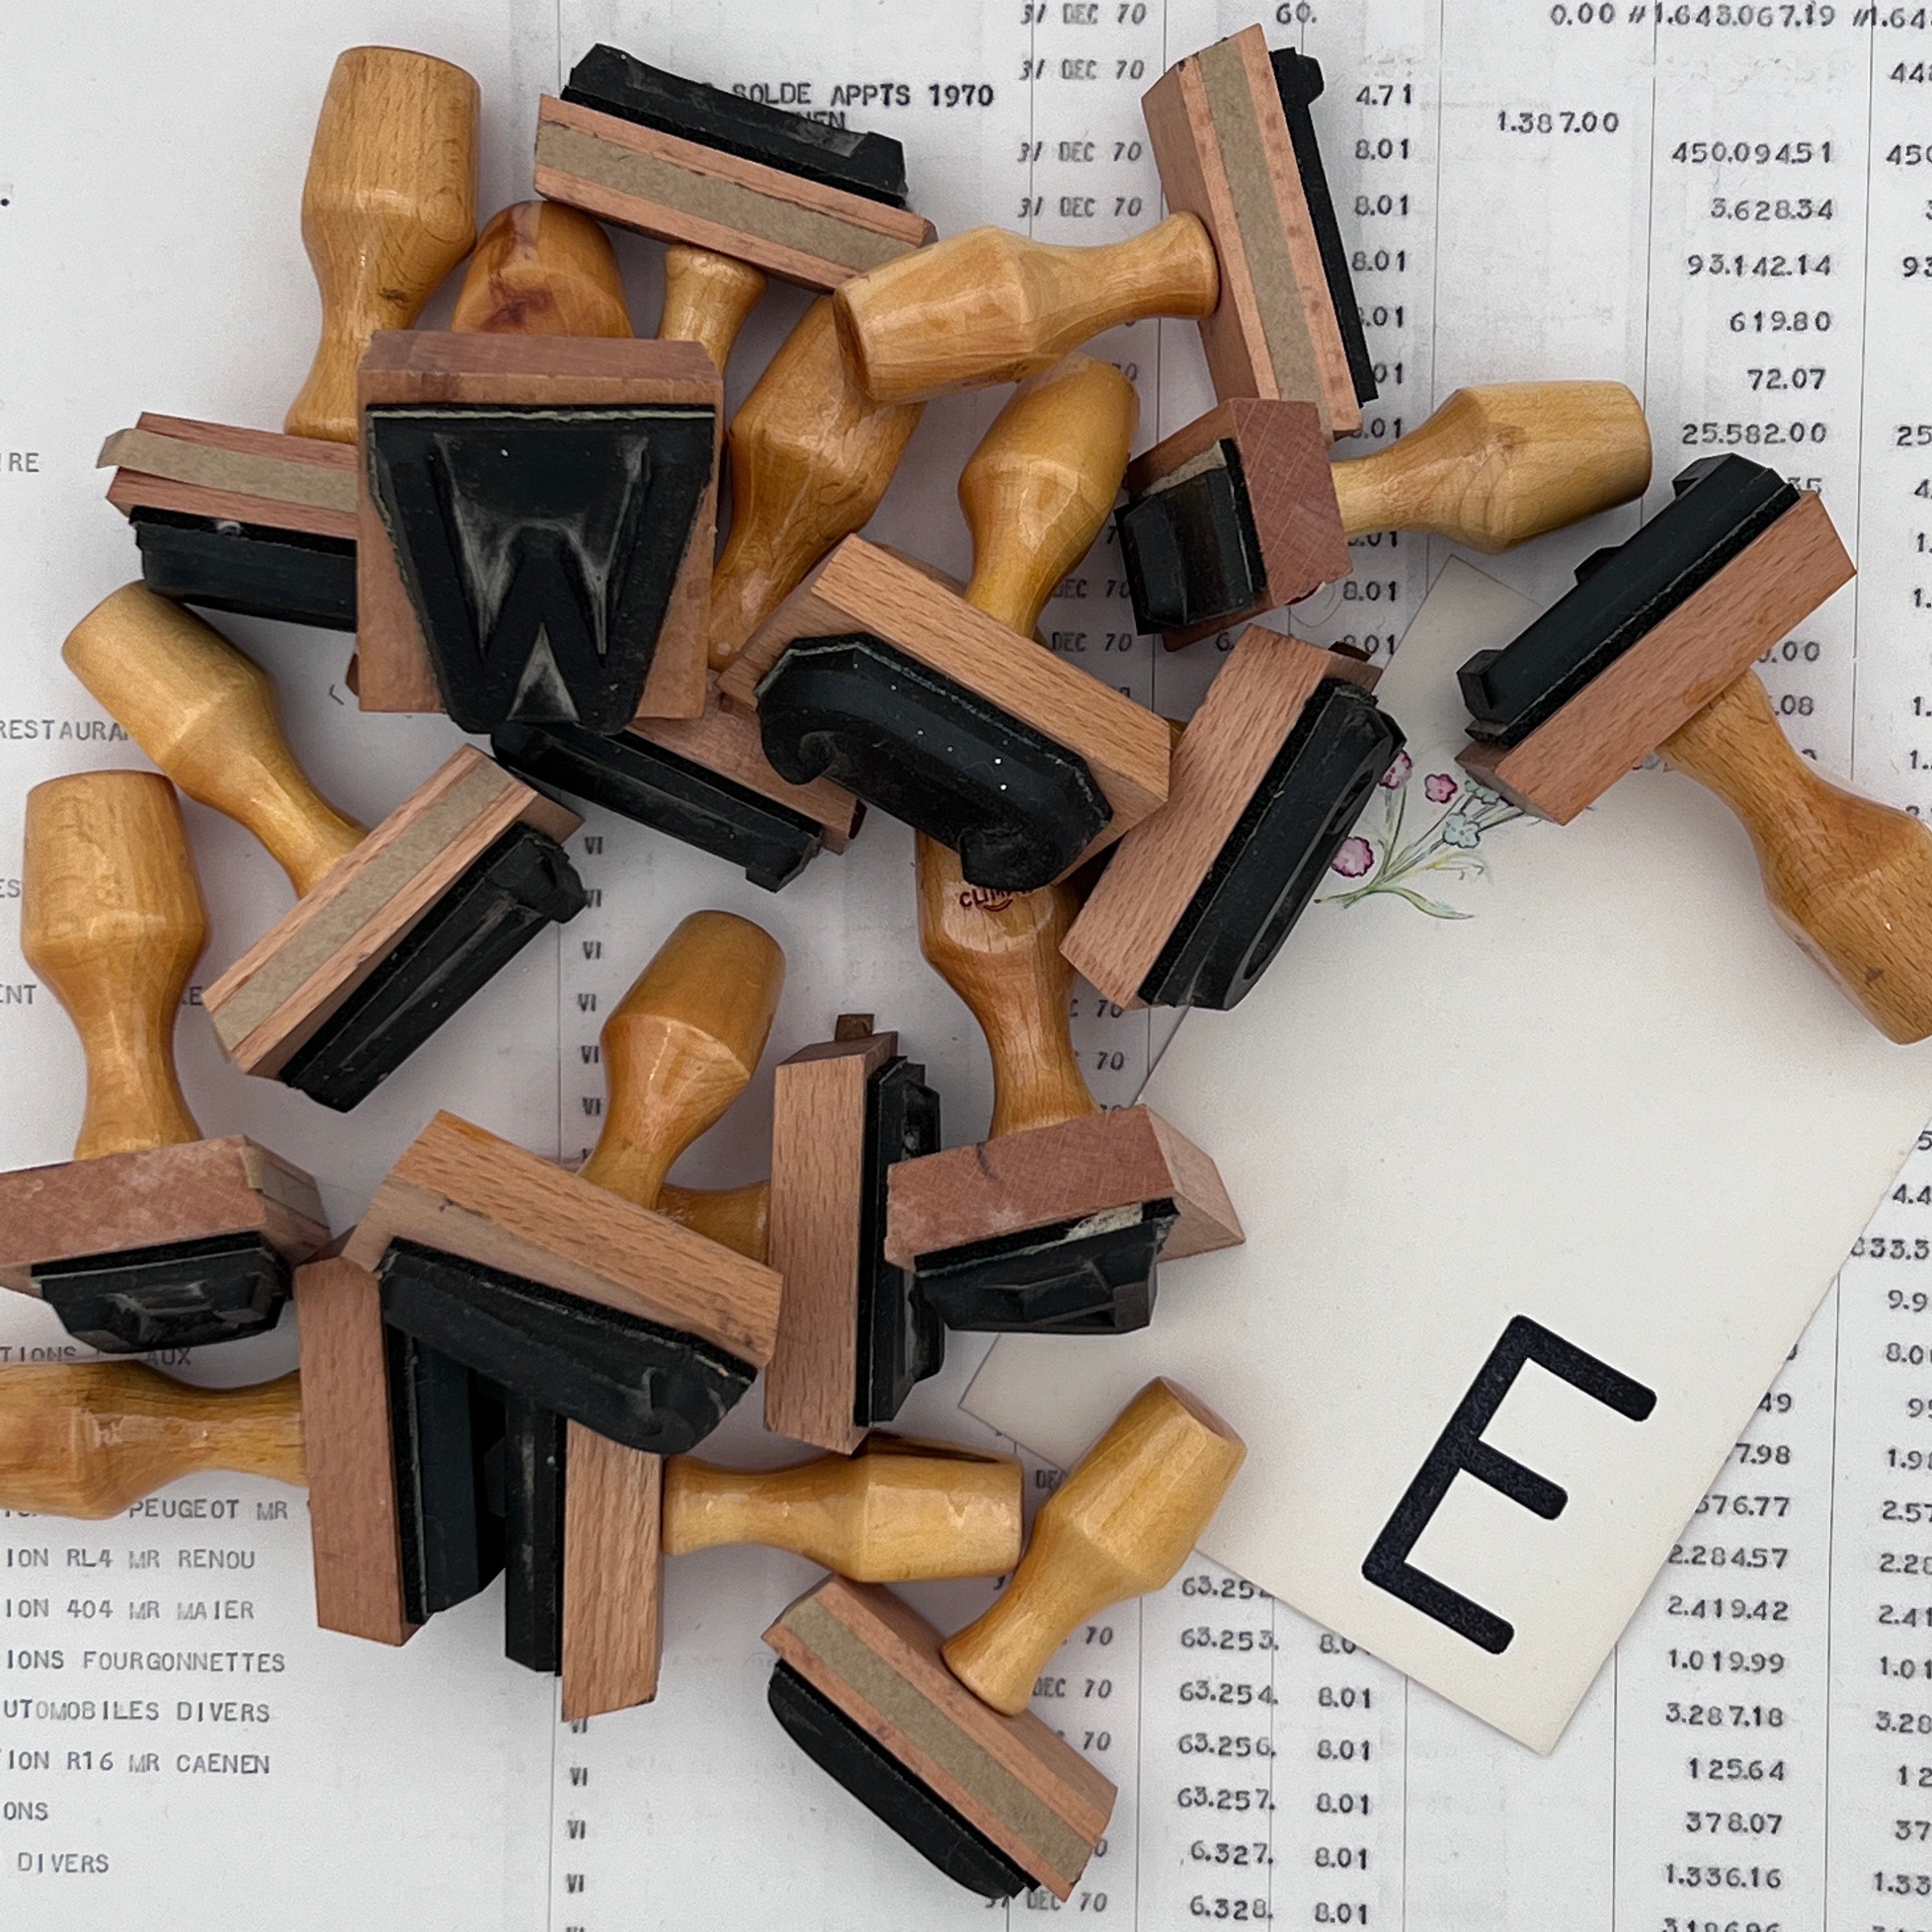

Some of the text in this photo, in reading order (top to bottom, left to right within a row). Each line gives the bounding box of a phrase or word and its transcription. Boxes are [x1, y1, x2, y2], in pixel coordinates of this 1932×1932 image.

[1020, 3, 1146, 25] 31 DEC 70
[1550, 3, 1615, 26] 0.00
[1018, 59, 1145, 80] 31 DEC 70
[1889, 62, 1932, 83] 44
[732, 82, 995, 108] SOLDE APPTS 1970
[1356, 84, 1412, 106] 4.71
[1499, 111, 1618, 133] 1.387.00
[1016, 141, 1142, 162] 31 DEC 70
[1356, 138, 1408, 160] 8.01
[1017, 196, 1142, 218] 31 DEC 70
[1355, 194, 1408, 216] 8.01
[1352, 250, 1406, 272] 8.01
[1730, 310, 1832, 332] 619.80
[1747, 368, 1826, 390] 72.07
[1681, 422, 1826, 444] 25.582.00
[0, 452, 39, 472] RE
[1343, 581, 1396, 601] 8.01
[1052, 632, 1132, 652] DEC 70
[0, 984, 37, 1005] NT
[1097, 1051, 1124, 1070] 70
[1886, 1343, 1932, 1365] 8.0
[1361, 1314, 1657, 1655] E
[129, 1499, 288, 1520] PEUGEOT MR
[67, 1548, 113, 1567] RL4
[129, 1549, 160, 1569] MR
[178, 1549, 256, 1569] RENOU
[67, 1599, 113, 1619] 404
[129, 1600, 160, 1620] MR
[177, 1600, 254, 1620] MAIER
[1668, 1595, 1788, 1621] 2.419.42
[1086, 1626, 1112, 1645] 70
[83, 1651, 285, 1673] FOURGONNETTES
[1669, 1649, 1785, 1673] 1.019.99
[1032, 1677, 1112, 1698] DEC 70
[1318, 1687, 1371, 1709] 8.01
[3, 1699, 270, 1723] UTOMOBILES DIVERS
[1083, 1731, 1112, 1752] 70
[1317, 1739, 1370, 1761] 8.01
[0, 1748, 270, 1774] ION R16 MR CAENEN
[1316, 1793, 1370, 1815] 8.01
[1686, 1811, 1783, 1835] 378.07
[17, 1852, 109, 1874] DIVERS
[1314, 1847, 1368, 1871] 8.01
[1666, 1864, 1781, 1889] 1.336.16
[1080, 1892, 1107, 1912] 70
[1314, 1902, 1368, 1926] 8.01
